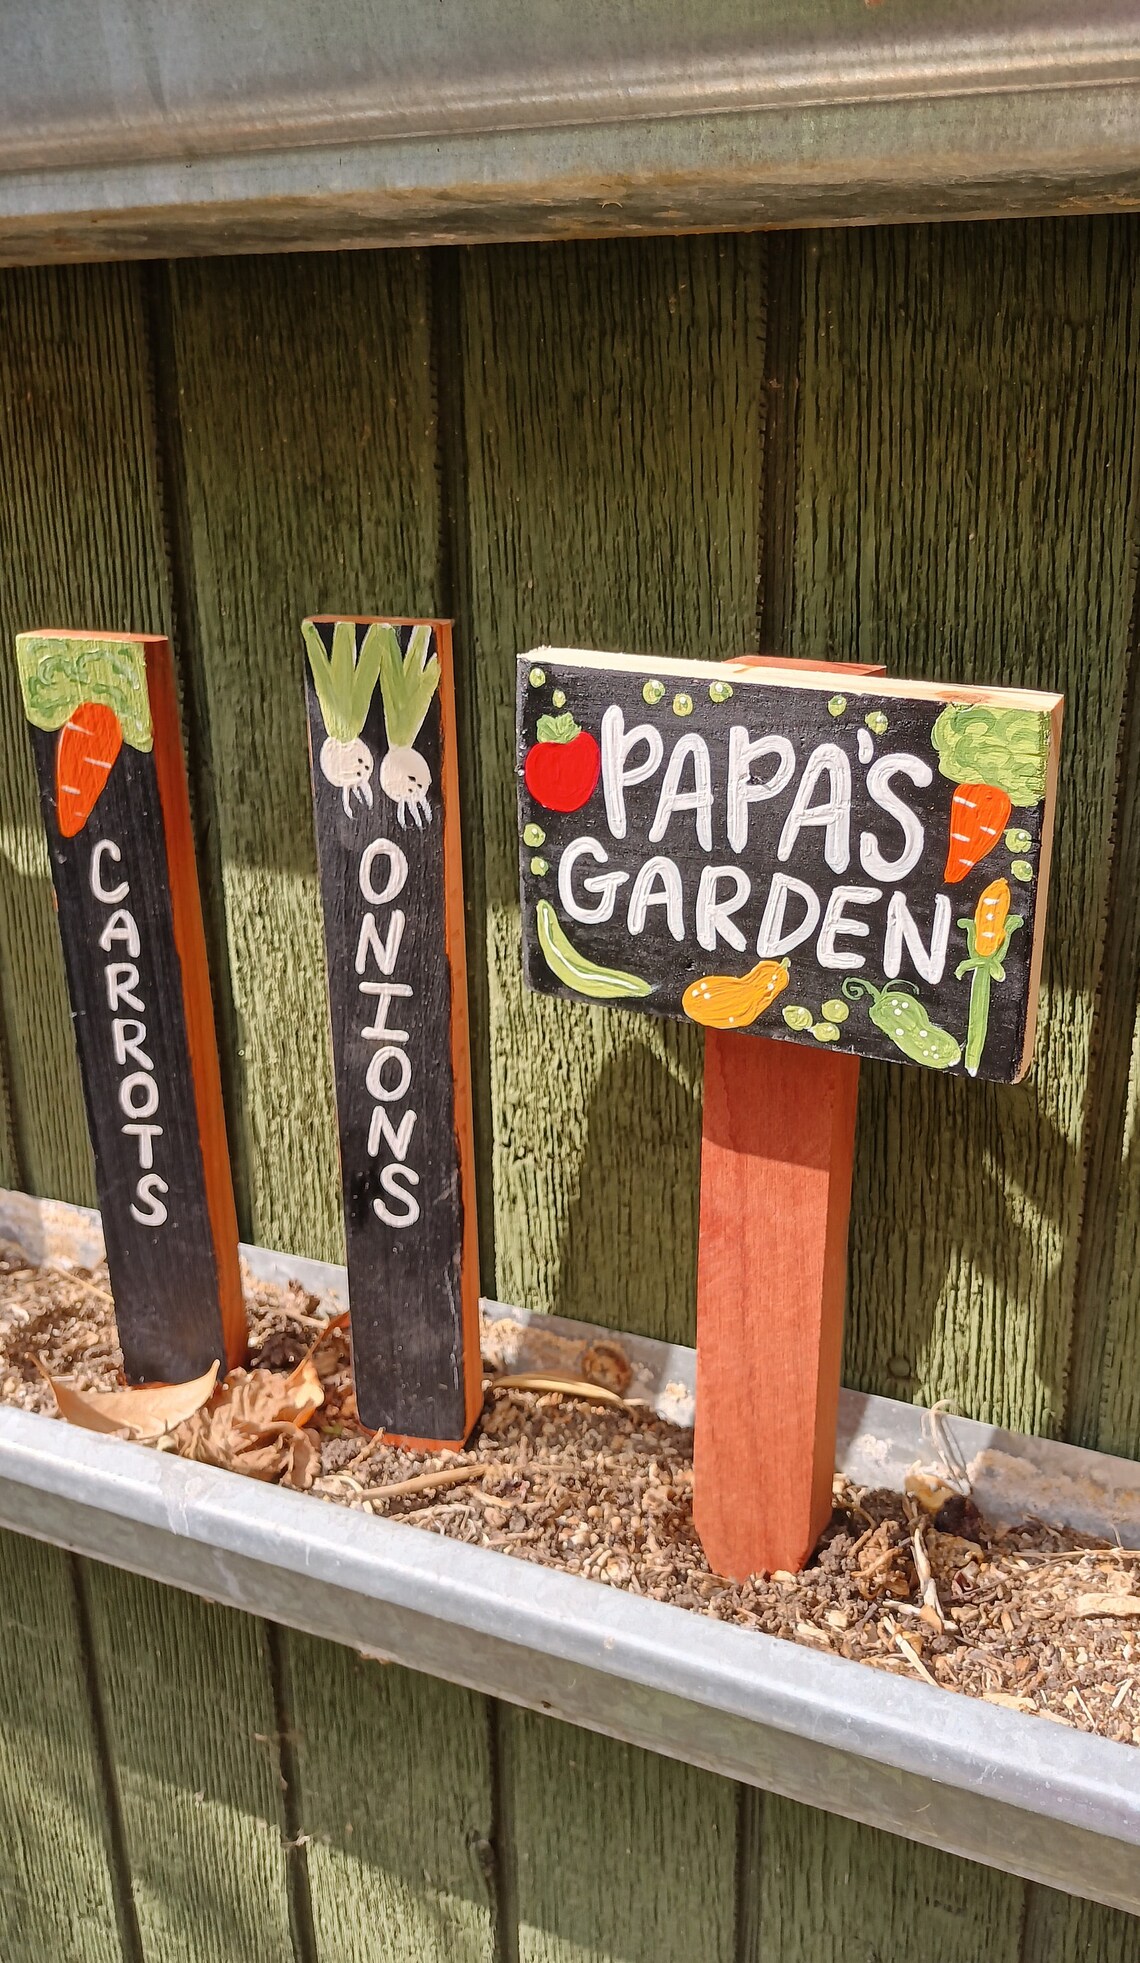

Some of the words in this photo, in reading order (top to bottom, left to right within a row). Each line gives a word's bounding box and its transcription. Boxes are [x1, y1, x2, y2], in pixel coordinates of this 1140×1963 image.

[557, 836, 952, 985] GARDEN
[600, 704, 933, 883] PAPA'S
[88, 838, 169, 1227] CARROTS
[354, 837, 420, 1229] ONIONS
